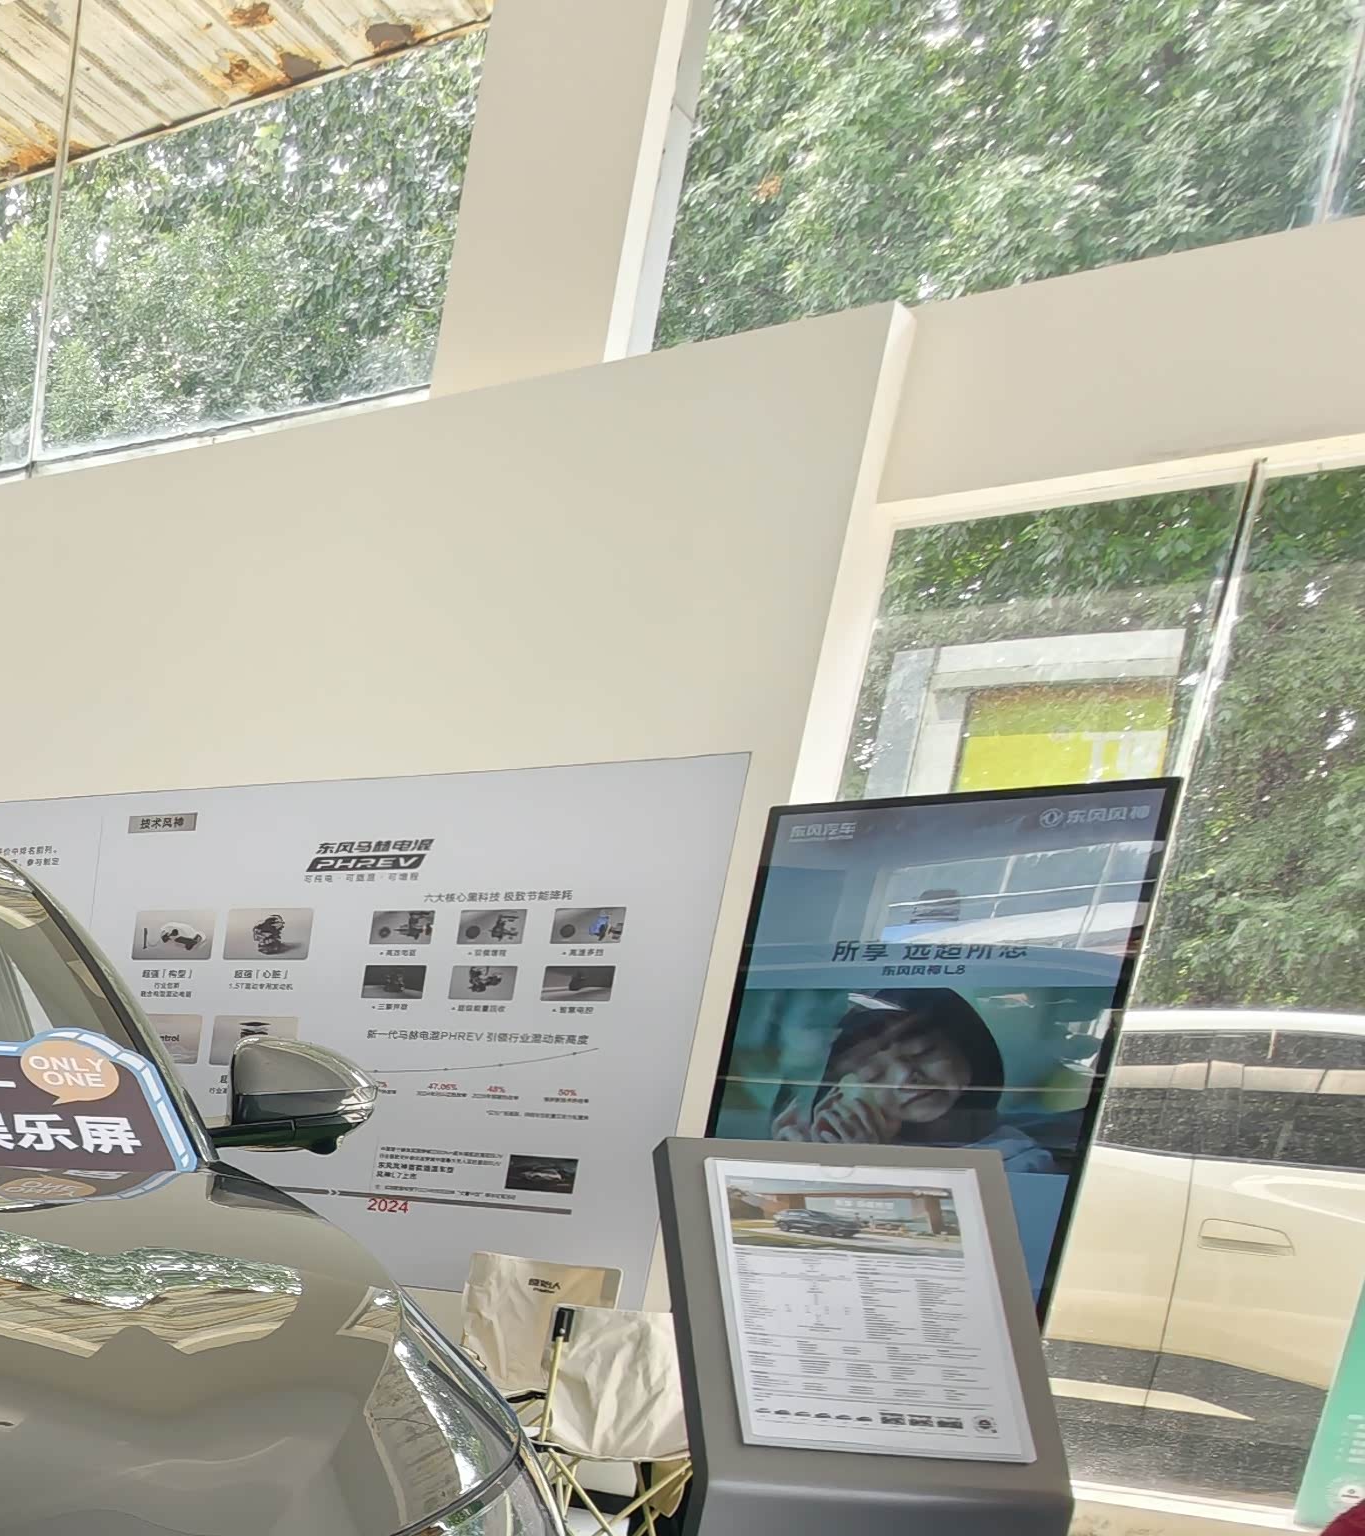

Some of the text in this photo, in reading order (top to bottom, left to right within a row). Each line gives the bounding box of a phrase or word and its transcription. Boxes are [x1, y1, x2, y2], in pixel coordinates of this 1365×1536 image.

[1066, 805, 1150, 824] 东风风神
[139, 817, 185, 830] 技术风神
[790, 822, 857, 839] 东风汽车
[316, 857, 420, 869] PHREV
[832, 940, 889, 961] 所享
[881, 964, 965, 976] 东风风神L8
[28, 1055, 105, 1075] ONLY
[42, 1070, 105, 1089] ONE
[367, 1198, 409, 1214] 2024
